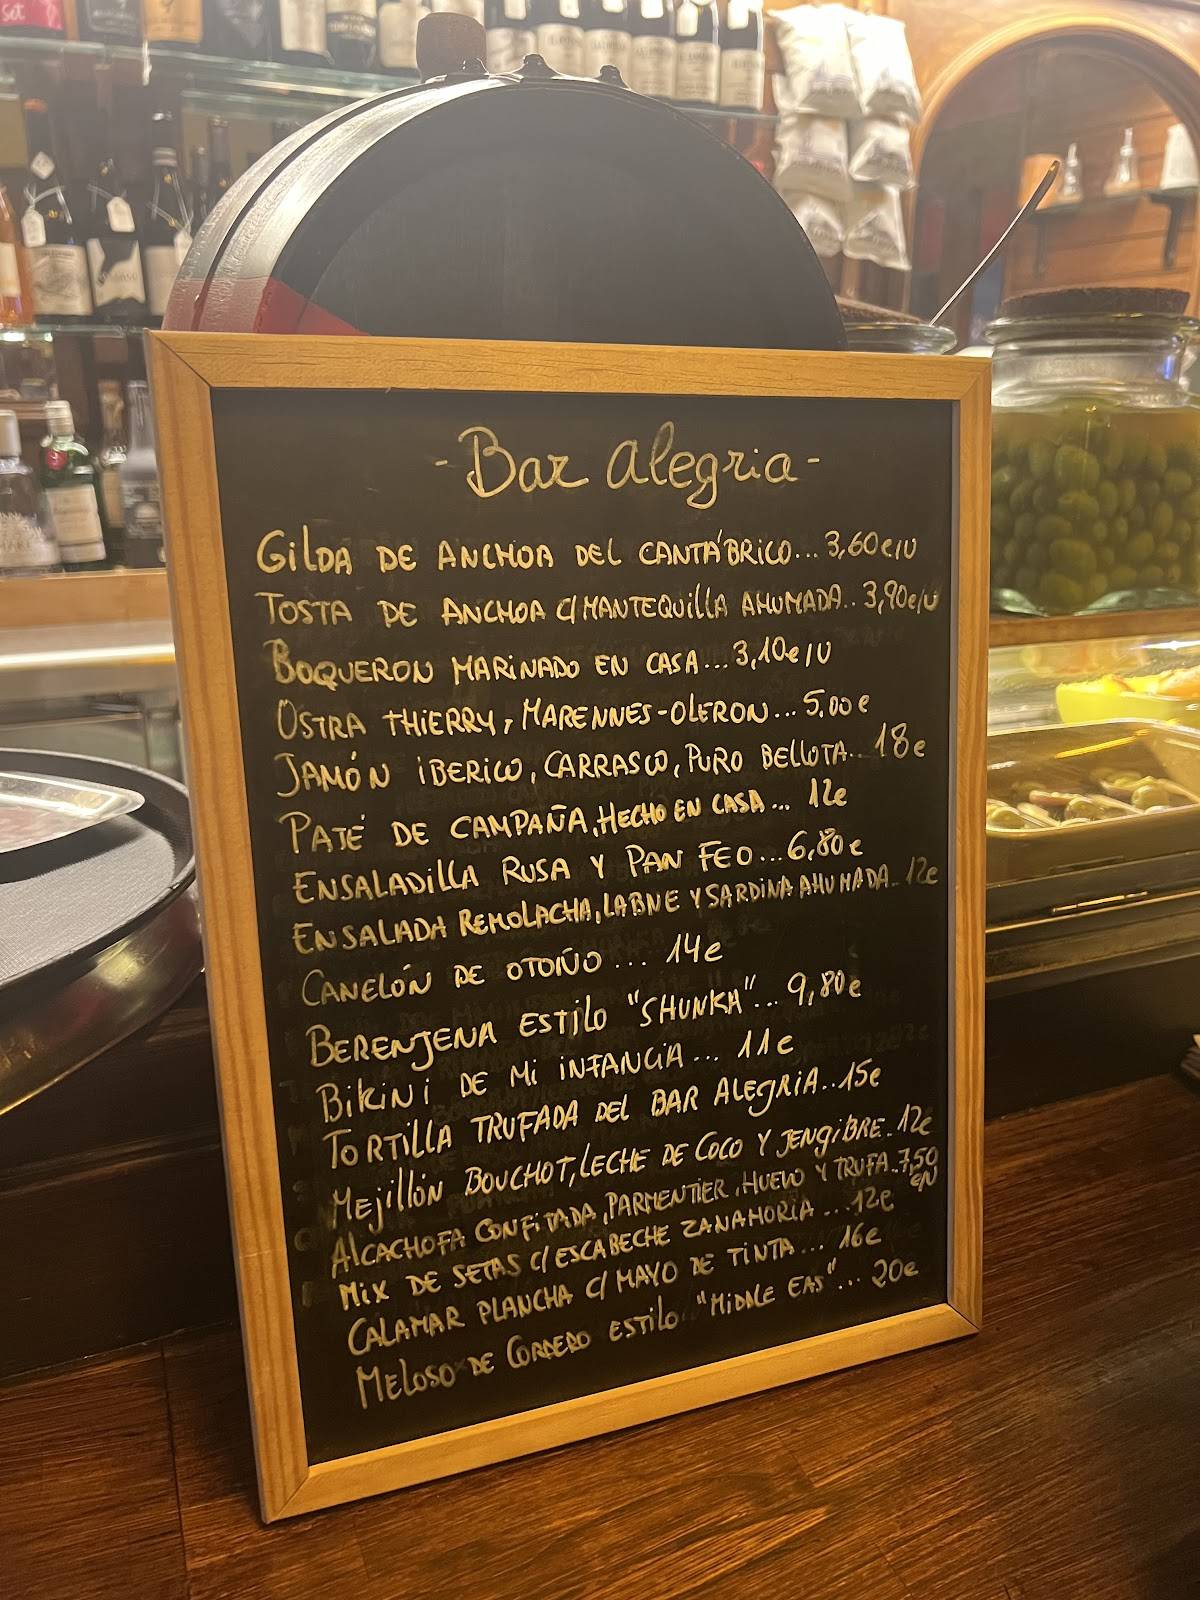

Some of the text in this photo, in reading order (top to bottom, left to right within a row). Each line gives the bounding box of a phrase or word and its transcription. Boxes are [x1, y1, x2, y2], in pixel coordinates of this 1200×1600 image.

[375, 543, 418, 574] DE
[437, 539, 554, 572] ANCHOA
[574, 537, 622, 568] DEL
[253, 591, 353, 626] TOSTA
[376, 599, 419, 629] DE
[440, 595, 547, 627] ANCHOA
[262, 637, 435, 693] BOQUERON
[593, 653, 629, 678] EN
[275, 698, 368, 742] OSTRA
[273, 749, 392, 799] JAMÓN
[684, 741, 745, 778] PURO
[277, 812, 368, 855] PATÉ
[390, 819, 431, 850] DE
[672, 796, 702, 824] EN
[500, 854, 572, 887] RUSA
[589, 853, 606, 880] Y
[624, 843, 684, 878] PAN
[291, 914, 449, 956] ENSALADA
[301, 962, 433, 1008] CANELÓN
[452, 963, 486, 989] DE
[505, 946, 603, 983] OTOÑO
[304, 1019, 499, 1073] BERENJENA
[458, 1070, 490, 1099] DE
[469, 1098, 580, 1145] TRUFADA
[593, 1093, 632, 1125] DEL
[650, 1084, 700, 1118] BAR
[661, 1142, 690, 1169] DE
[694, 1129, 745, 1163] COCO
[757, 1127, 774, 1158] Y
[330, 1227, 467, 1281] ALCACHOFA
[741, 1167, 807, 1198] HUEVO
[814, 1161, 829, 1184] Y
[404, 1270, 443, 1298] DE
[451, 1252, 523, 1290] SETAS
[347, 1304, 466, 1358] CALAMAR
[475, 1282, 575, 1327] PLANCHA
[615, 1260, 680, 1295] MAYO
[688, 1252, 716, 1278] DE
[355, 1356, 457, 1411] MELOSO
[466, 1350, 496, 1377] DE
